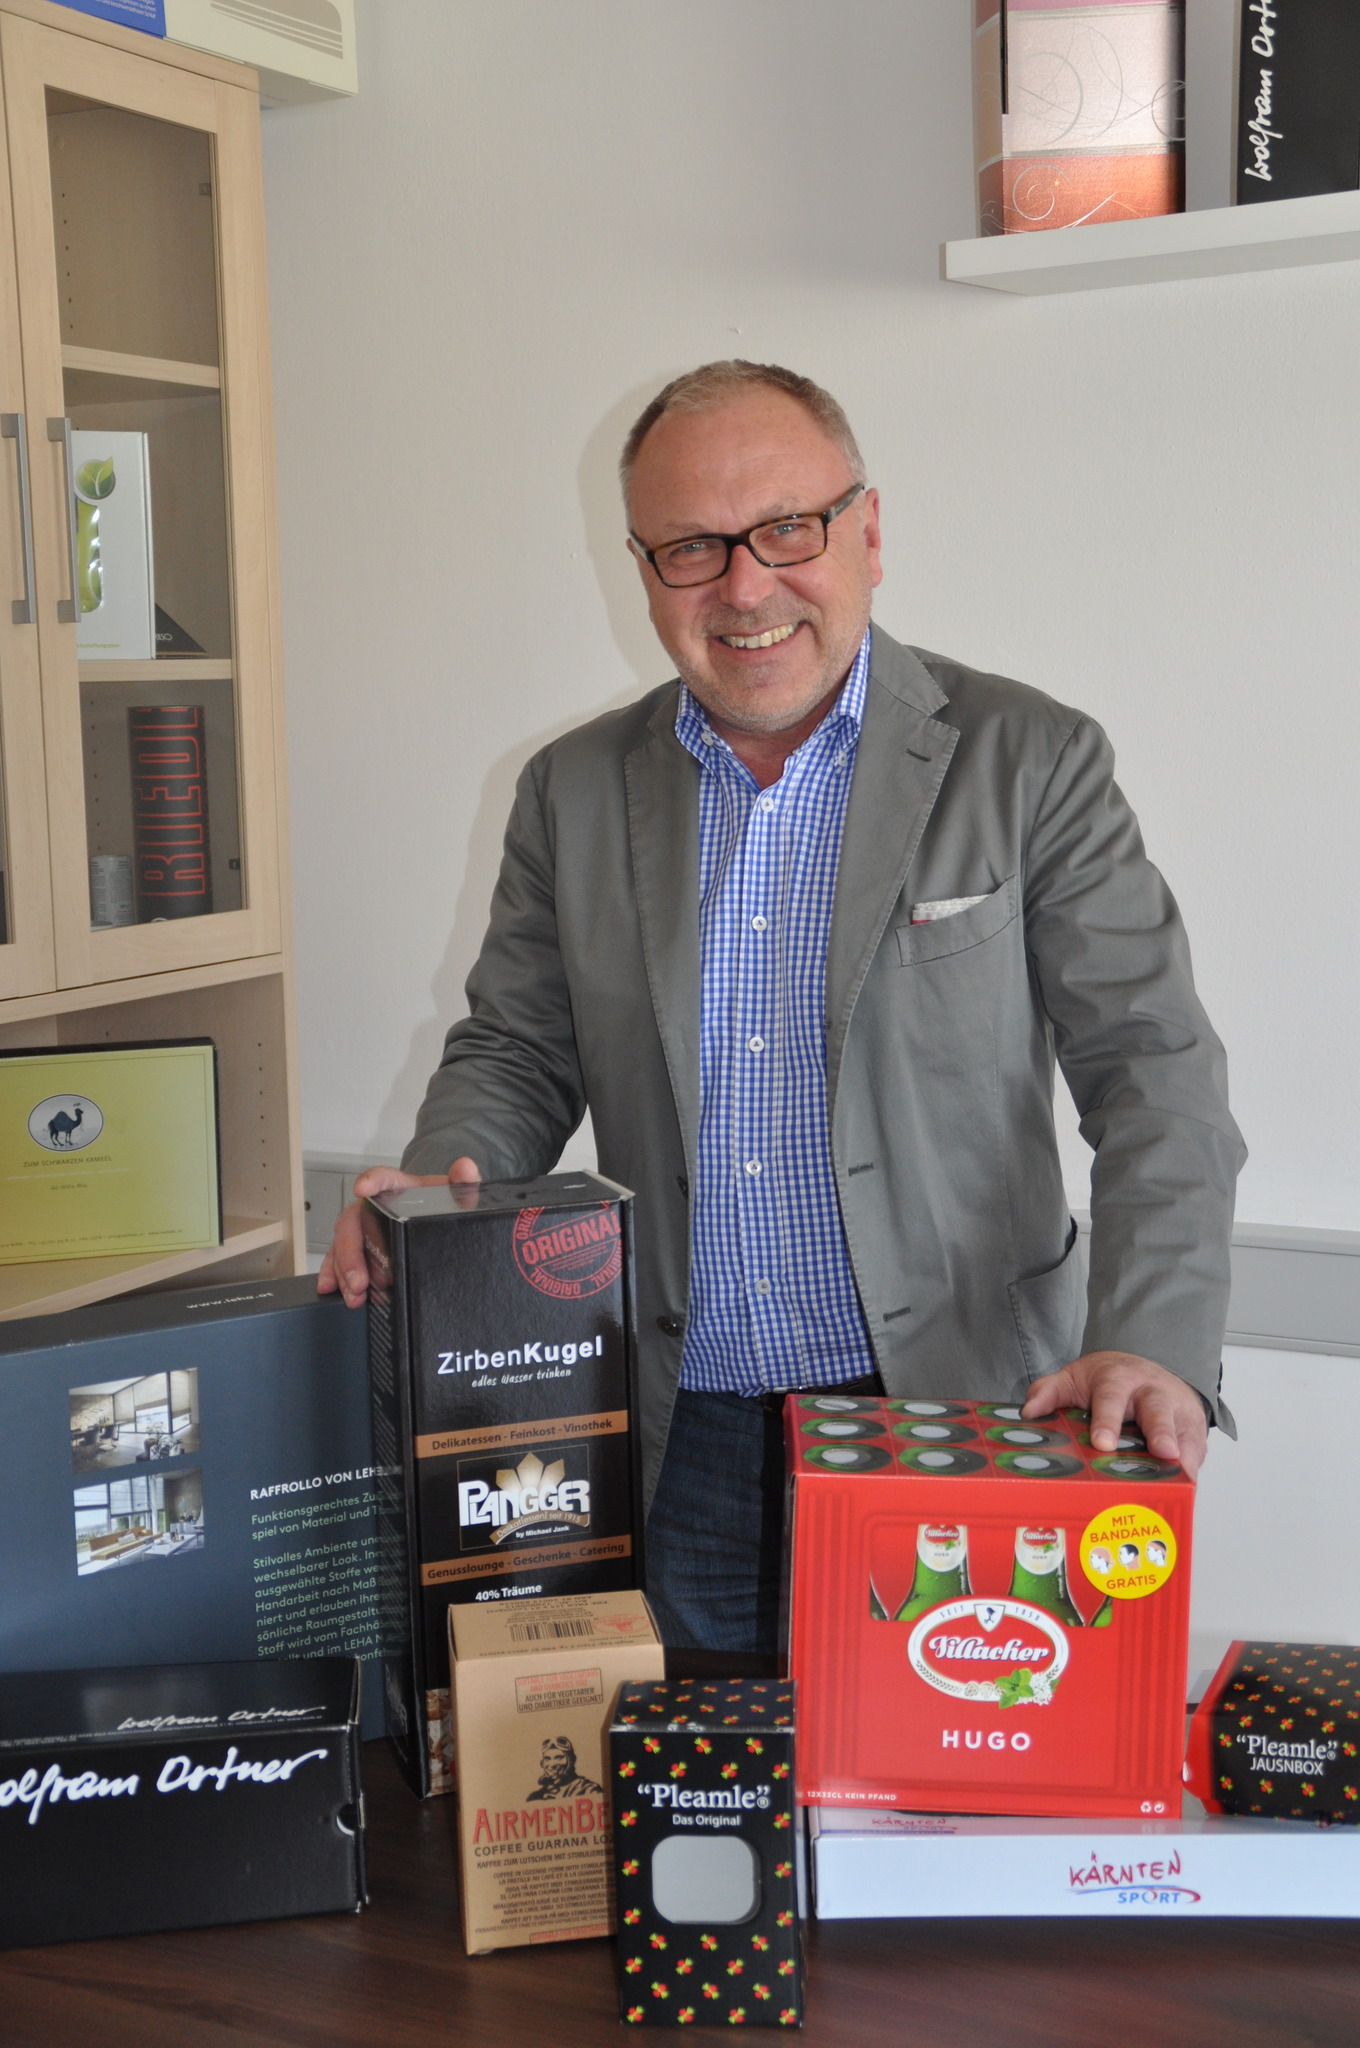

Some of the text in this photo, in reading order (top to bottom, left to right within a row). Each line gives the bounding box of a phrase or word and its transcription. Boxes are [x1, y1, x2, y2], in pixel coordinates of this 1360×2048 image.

[1247, 0, 1277, 58] Ort
[186, 1292, 274, 1309] www.leha.at
[437, 1335, 602, 1374] ZirbenKugel
[471, 1375, 497, 1388] edles
[536, 1367, 572, 1381] trinken
[432, 1419, 612, 1451] Delikatessen Feinkost Vinothek
[250, 1477, 322, 1500] RAFFROLLO
[325, 1471, 352, 1485] VON
[251, 1496, 360, 1525] Funktionsgerechtes
[458, 1480, 590, 1527] PLANGGER
[251, 1525, 277, 1541] spiel
[279, 1523, 299, 1534] von
[301, 1512, 347, 1530] Material
[349, 1506, 370, 1520] und
[549, 1511, 562, 1520] seit
[564, 1513, 581, 1524] 1915
[1111, 1513, 1136, 1527] MIT
[525, 1527, 552, 1537] Michael
[553, 1525, 570, 1533] Jank
[1089, 1525, 1162, 1544] BANDANA
[253, 1552, 302, 1569] Stilvolles
[304, 1540, 358, 1559] Ambiente
[427, 1543, 625, 1580] Genusslounge Geschenke Catering
[254, 1559, 329, 1584] wechselbarer
[332, 1552, 362, 1567] Look.
[254, 1576, 326, 1598] ausgewählte
[328, 1567, 361, 1582] Stoffe
[475, 1583, 542, 1602] 40% Träume
[1106, 1574, 1157, 1590] GRATIS
[255, 1577, 377, 1613] Handarbeit nach Maß
[256, 1592, 380, 1628] niert und erlauben Ihre
[940, 1605, 1041, 1622] SEIT 1858
[256, 1606, 380, 1642] sönliche Raumgestaltu
[257, 1641, 285, 1657] Stoff
[287, 1635, 311, 1650] wird
[313, 1631, 338, 1643] vom
[340, 1620, 380, 1638] Fachhä
[327, 1644, 341, 1656] im
[344, 1635, 373, 1651] LEHA
[928, 1634, 1049, 1664] Villacher
[518, 1694, 602, 1712] UND DIABETIKER GEEIGNET
[525, 1687, 595, 1703] AUCH FÜR VEGETARIER
[942, 1729, 1031, 1752] HUGO
[1250, 1757, 1324, 1776] JAUSNBOX
[0, 1746, 328, 1825] olfram Ortner
[807, 1791, 842, 1799] 12X33CL
[868, 1793, 897, 1801] PFAND
[672, 1814, 741, 1828] Das Original
[474, 1842, 523, 1857] COFFEE
[527, 1837, 588, 1851] GUARANA
[476, 1860, 501, 1869] KAFFEE
[503, 1857, 518, 1866] ZUM
[519, 1854, 553, 1864] LUTSCHEN
[554, 1852, 566, 1861] MIT
[1069, 1848, 1183, 1887] KÄRNTEN
[1117, 1890, 1181, 1905] SPORT
